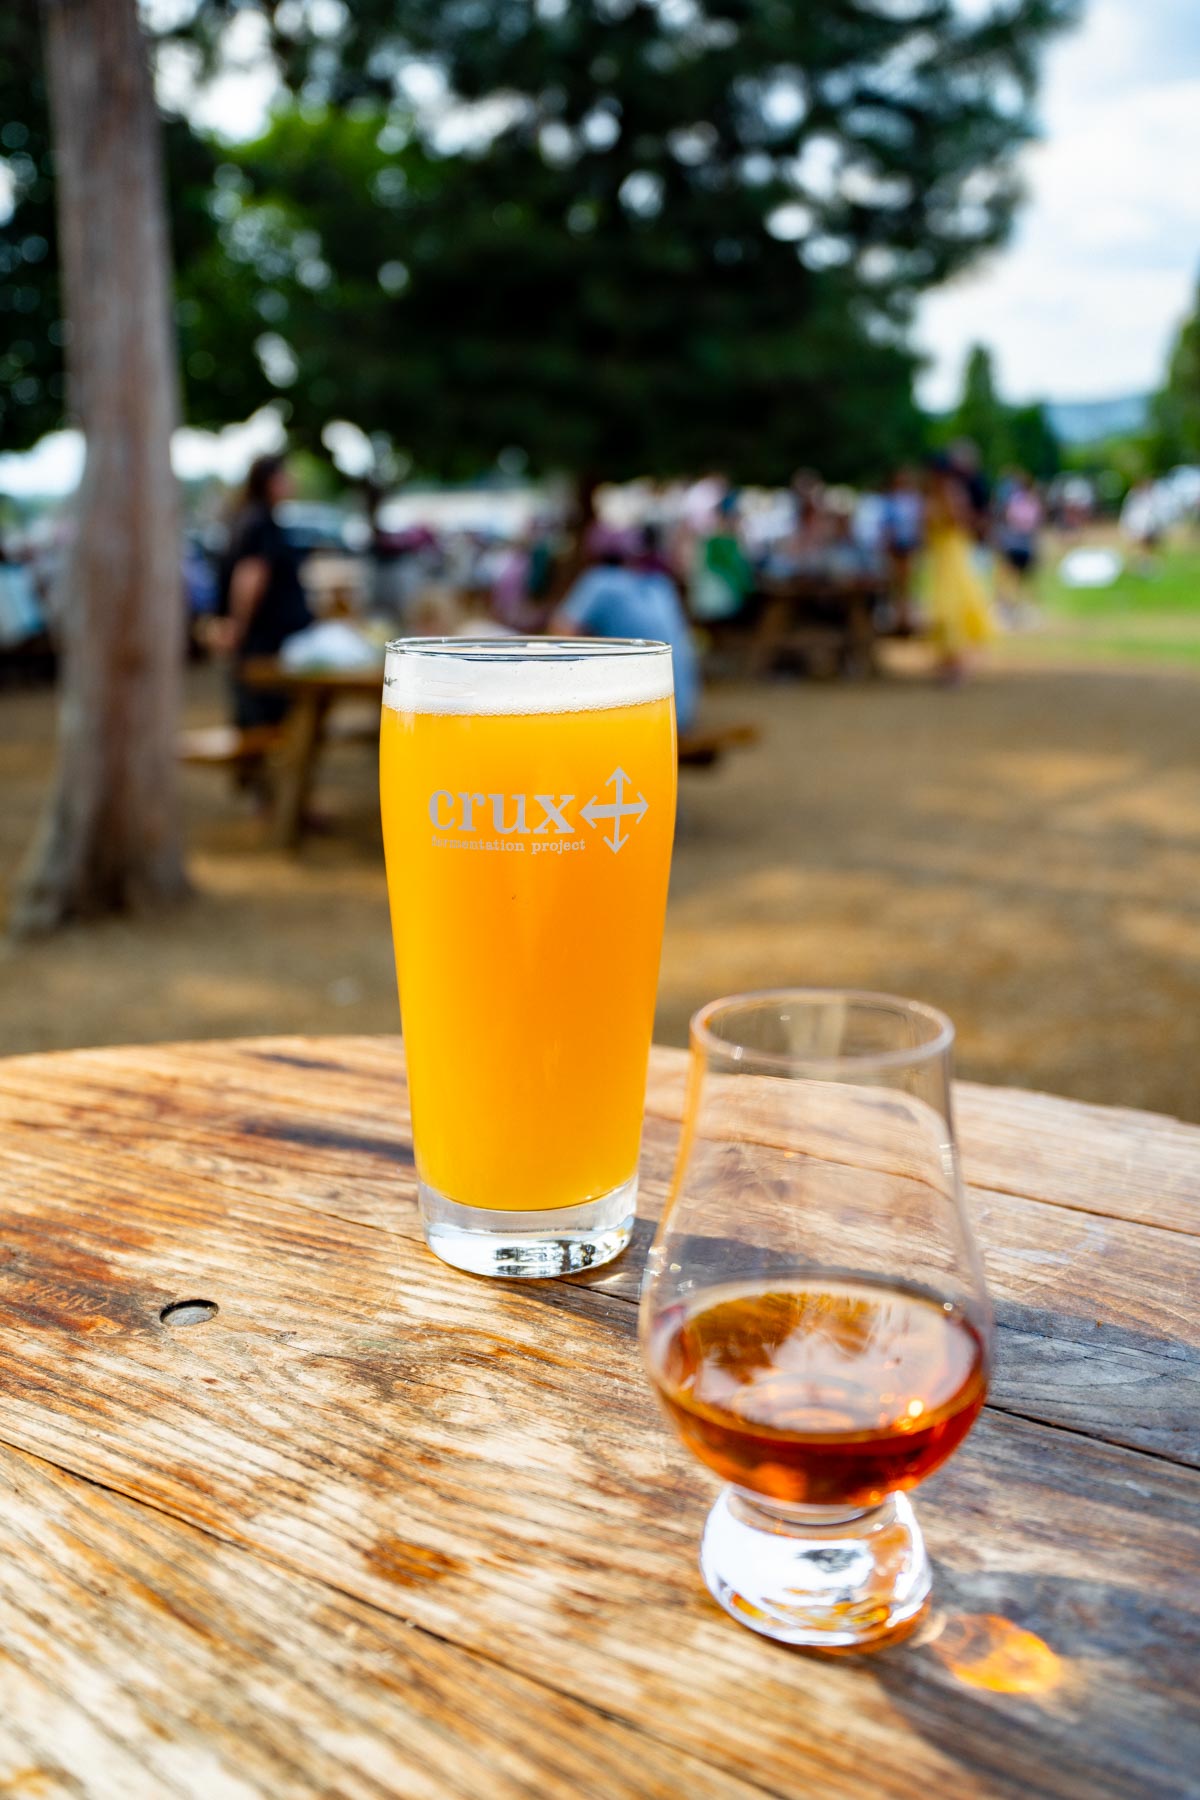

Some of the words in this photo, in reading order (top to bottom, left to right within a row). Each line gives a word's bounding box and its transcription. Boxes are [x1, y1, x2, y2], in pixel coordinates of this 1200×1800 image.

[429, 789, 575, 834] crux
[431, 835, 525, 852] fermentation
[531, 839, 586, 855] project
